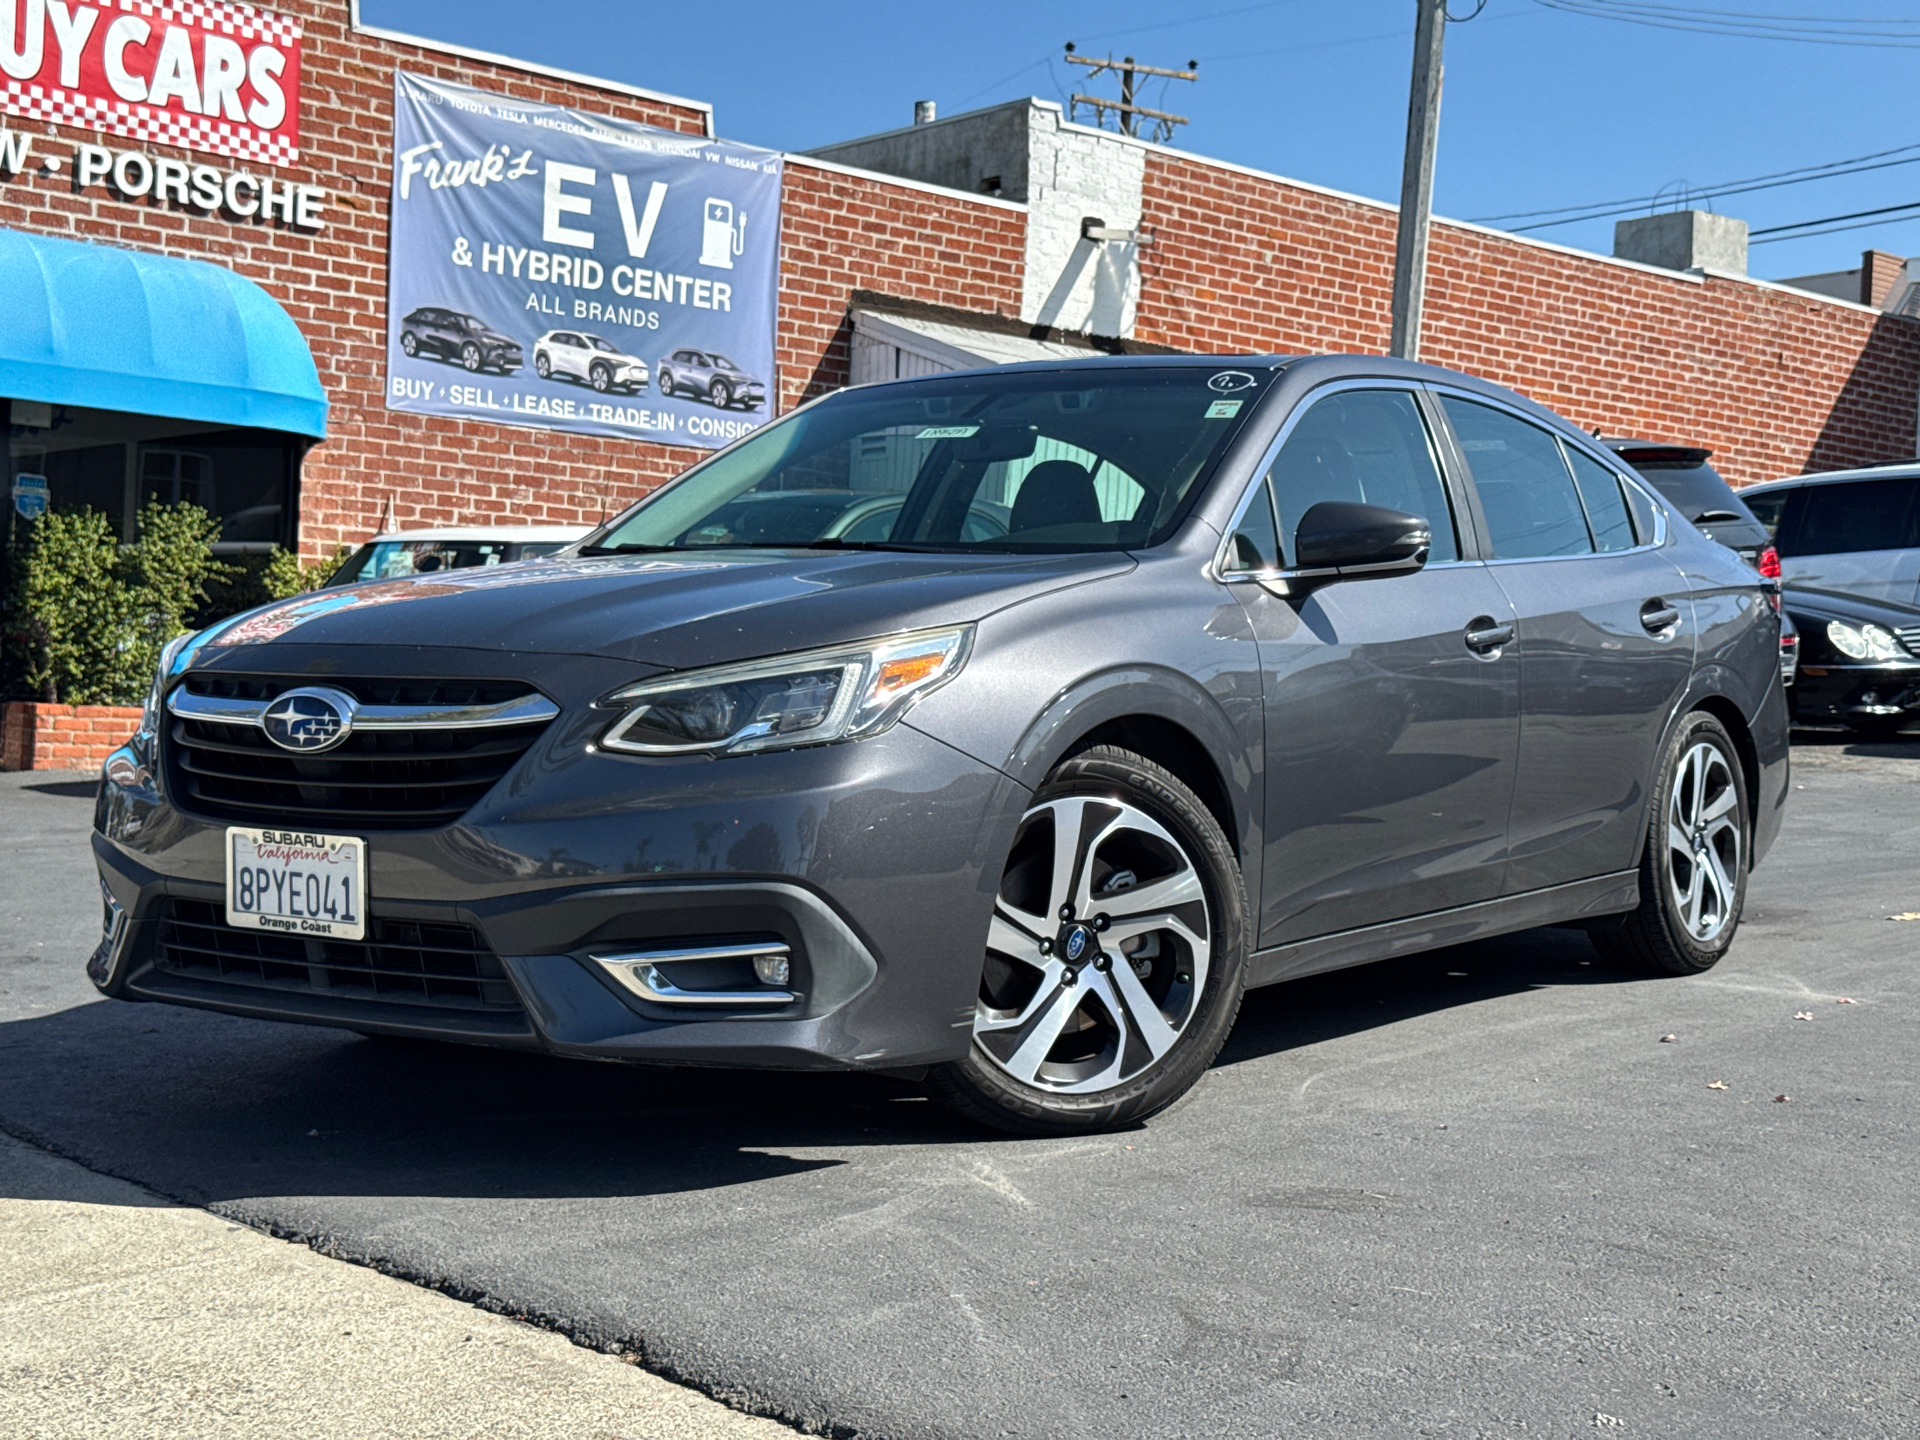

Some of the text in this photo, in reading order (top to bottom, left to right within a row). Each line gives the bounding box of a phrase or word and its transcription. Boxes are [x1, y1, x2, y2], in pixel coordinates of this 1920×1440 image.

[104, 14, 287, 130] CARS
[399, 86, 444, 106] SBARU
[450, 100, 491, 117] TOYOTA
[497, 110, 528, 124] TESLA
[534, 116, 587, 136] MERCEDES
[657, 142, 701, 160] HYUNDAI
[705, 151, 721, 164] VW
[725, 155, 758, 172] NISSAN
[80, 144, 326, 229] PORSCHE
[400, 141, 539, 200] Frank's
[542, 160, 669, 259] EV
[451, 237, 733, 312] & HYBRID CENTER
[525, 292, 660, 331] ALL BRANDS
[392, 376, 759, 439] BUY SELL LEASE TRADE-IN CONSIG
[257, 844, 340, 867] California
[262, 831, 326, 849] SUBARU
[239, 866, 356, 922] 8PYE041
[259, 915, 332, 934] Orange Coast
